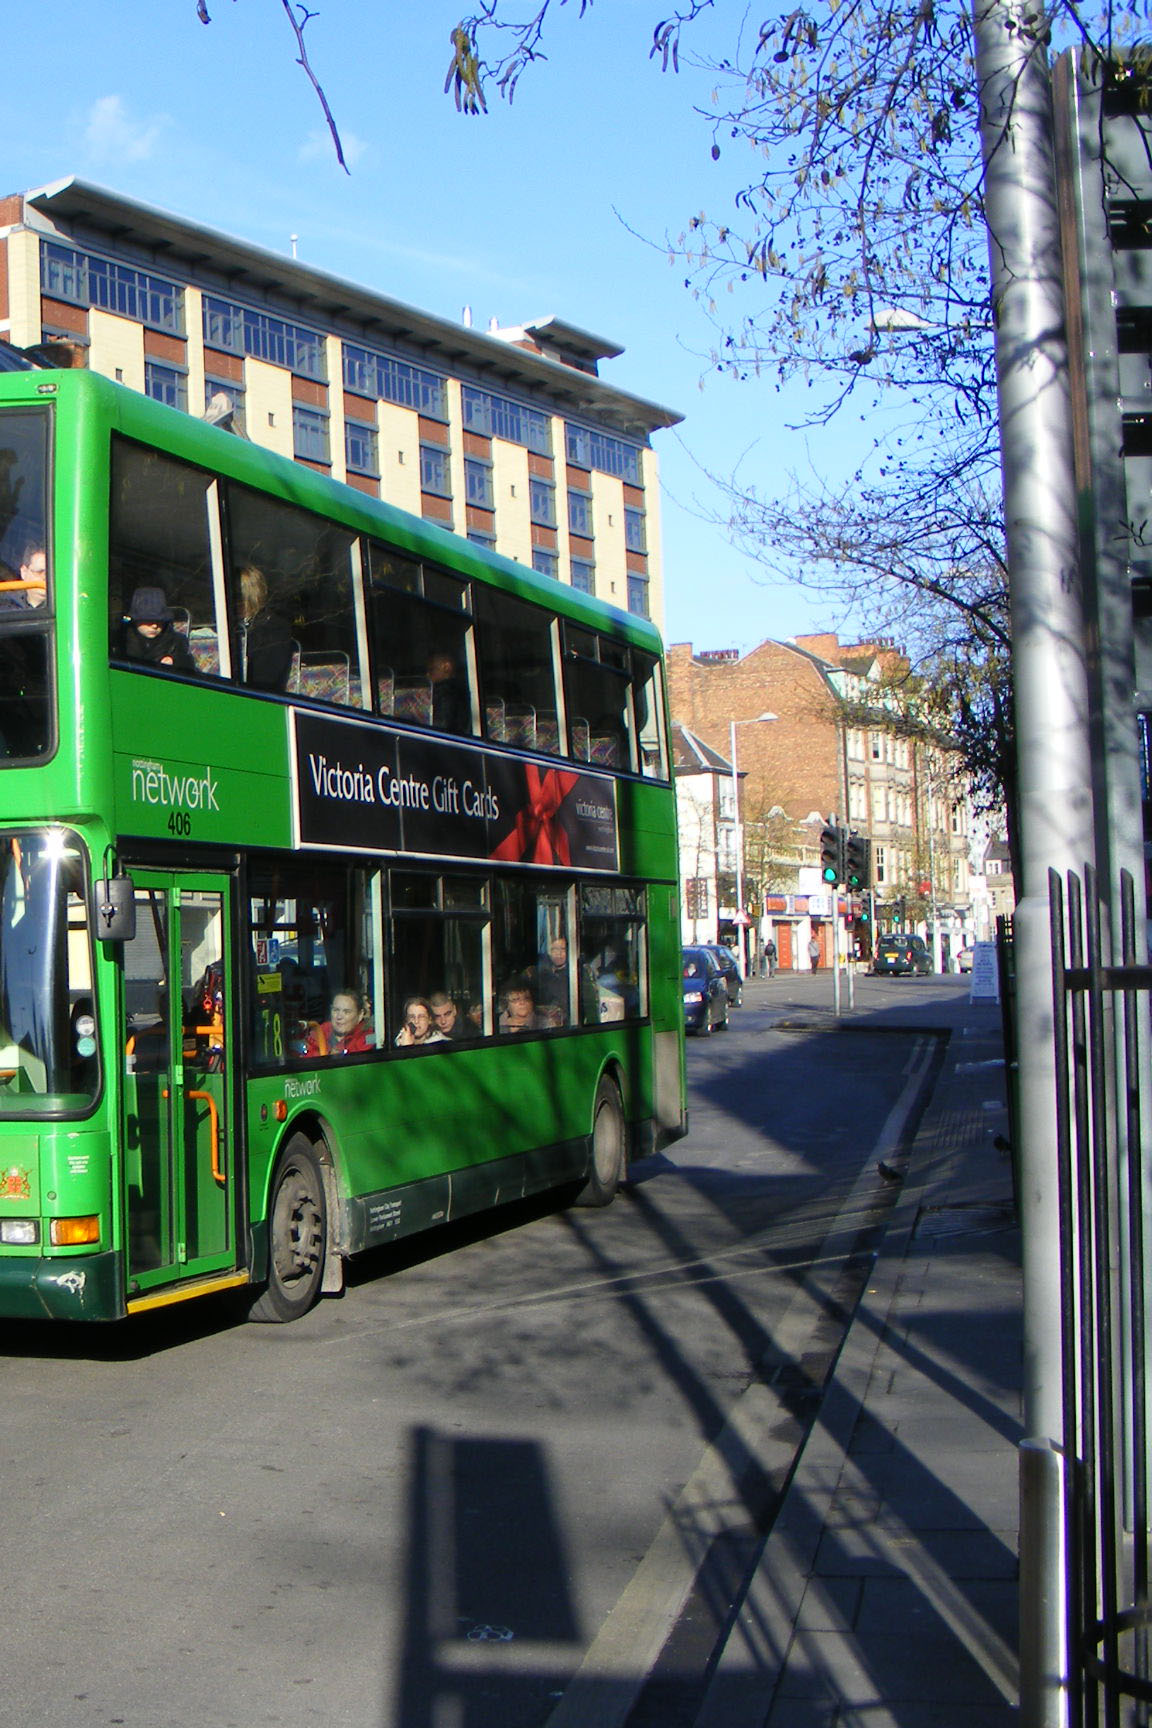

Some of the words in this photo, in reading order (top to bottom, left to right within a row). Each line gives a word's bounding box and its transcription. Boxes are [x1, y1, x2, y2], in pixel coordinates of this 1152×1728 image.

[132, 765, 220, 811] network
[310, 753, 374, 803] Victoria
[378, 765, 429, 810] Centre
[433, 775, 459, 814] Gift
[462, 780, 500, 820] Cards
[168, 811, 191, 836] 406
[284, 1073, 321, 1098] network
